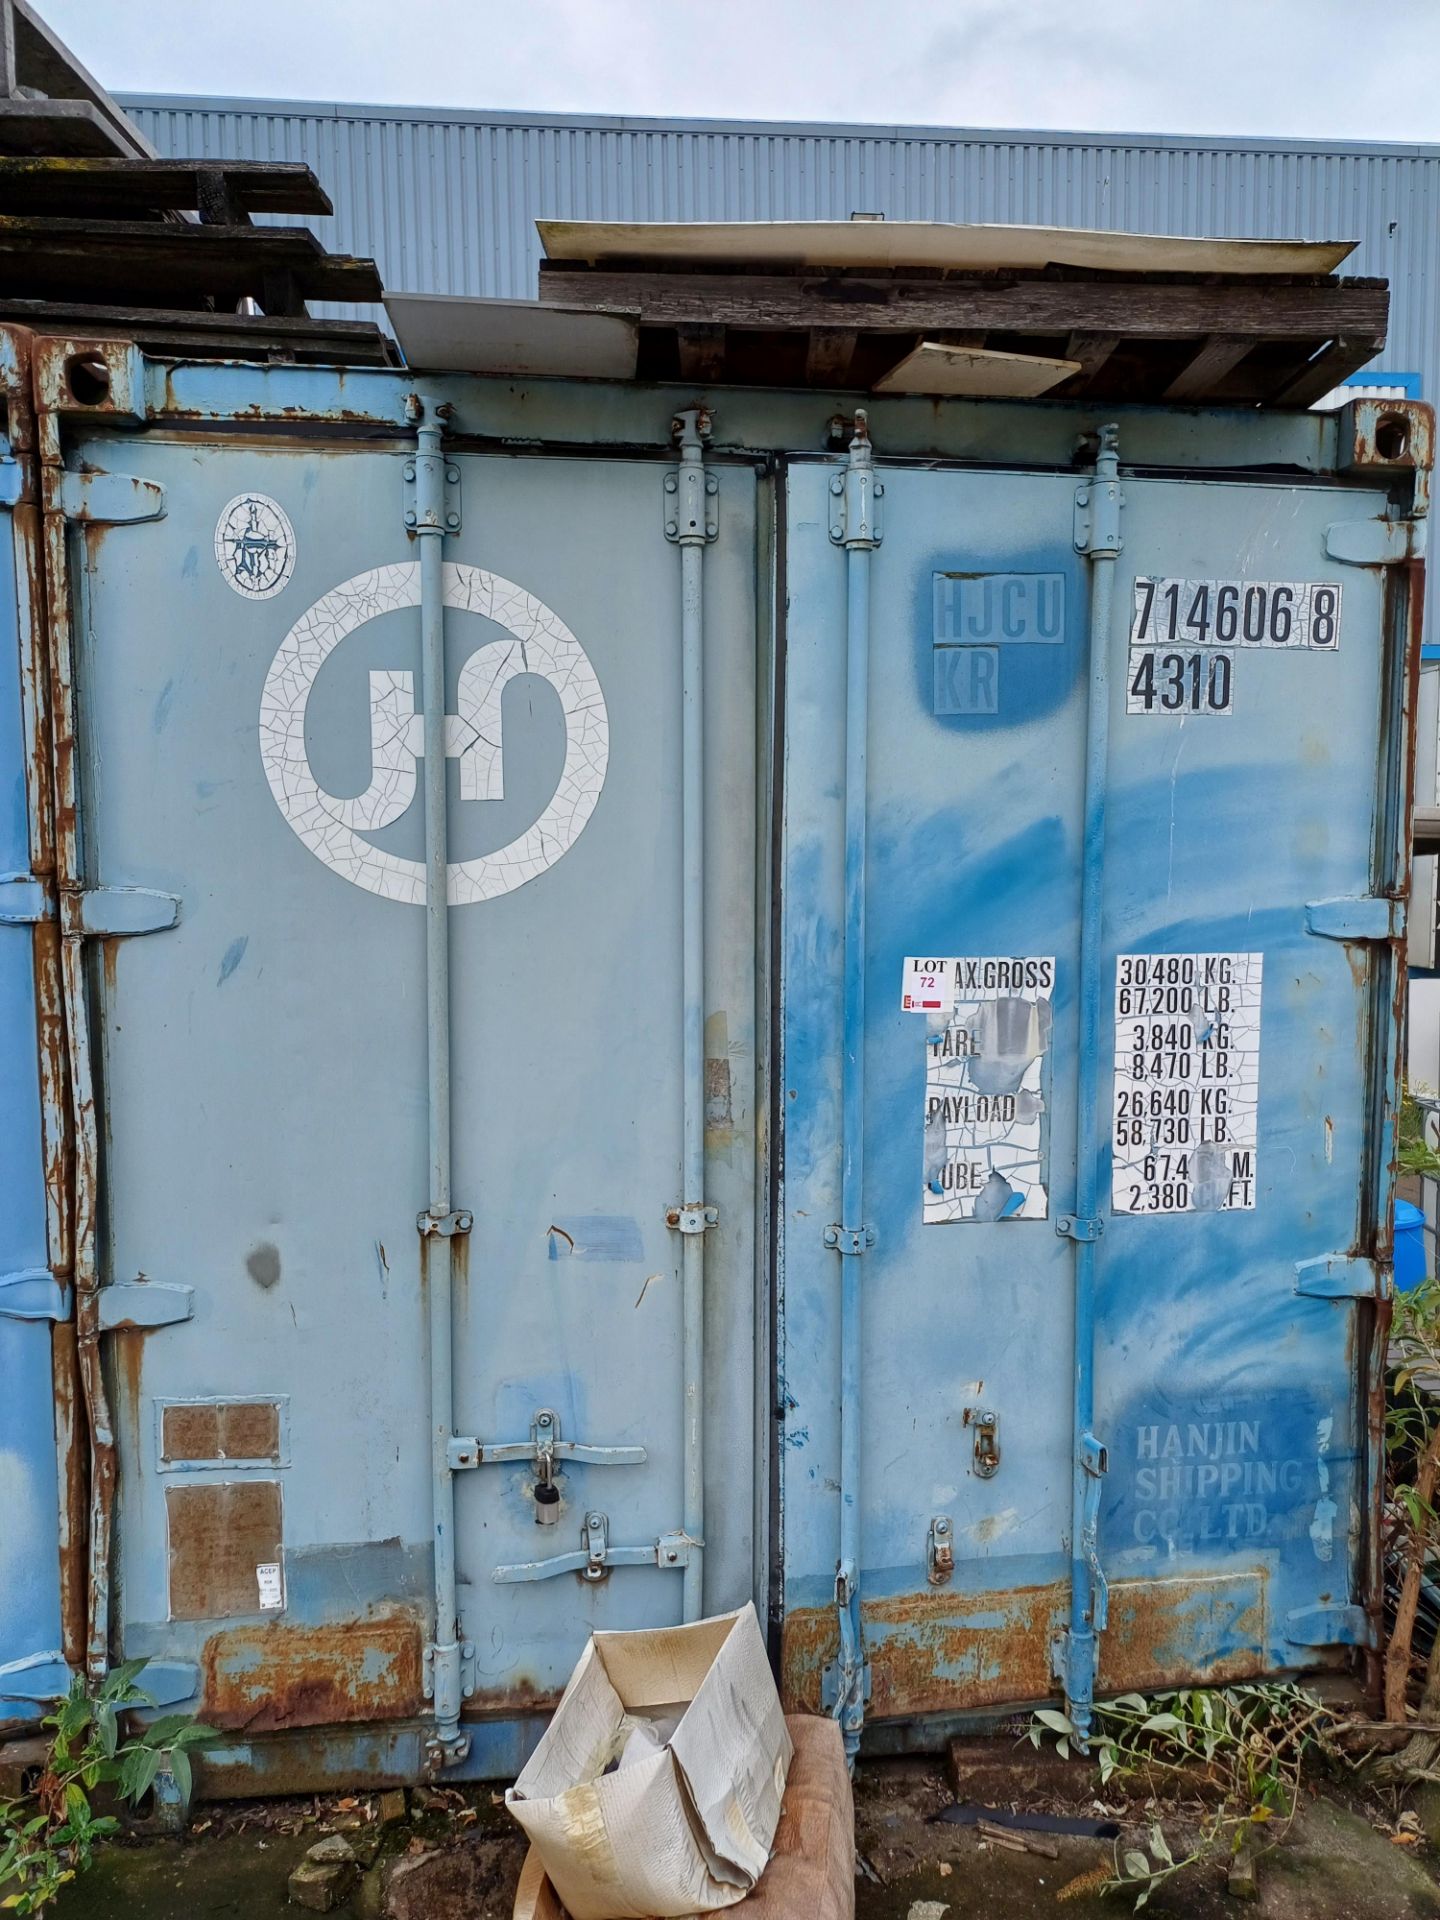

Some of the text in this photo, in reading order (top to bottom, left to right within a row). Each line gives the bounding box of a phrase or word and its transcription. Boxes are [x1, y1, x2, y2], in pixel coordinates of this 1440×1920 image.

[937, 579, 1061, 638] HJCU
[1135, 582, 1293, 642] 714606
[937, 651, 1231, 710] KR 4310
[913, 960, 947, 973] LOT
[954, 957, 1236, 989] AX.GROSS 30,480 KG.
[920, 977, 935, 988] 72
[1119, 986, 1235, 1015] 67,200 LB.
[1132, 1024, 1191, 1052] 3,840
[1132, 1052, 1233, 1081] 8,470 LB.
[928, 1088, 1232, 1123] PAYLOAD 26,640 KG.
[1116, 1117, 1190, 1146] 58,730
[928, 1162, 982, 1191] UBE
[1143, 1154, 1189, 1182] 67.4
[1129, 1183, 1188, 1211] 2,380
[1136, 1420, 1261, 1460] HANJIN
[1134, 1459, 1302, 1501] SHIPPING
